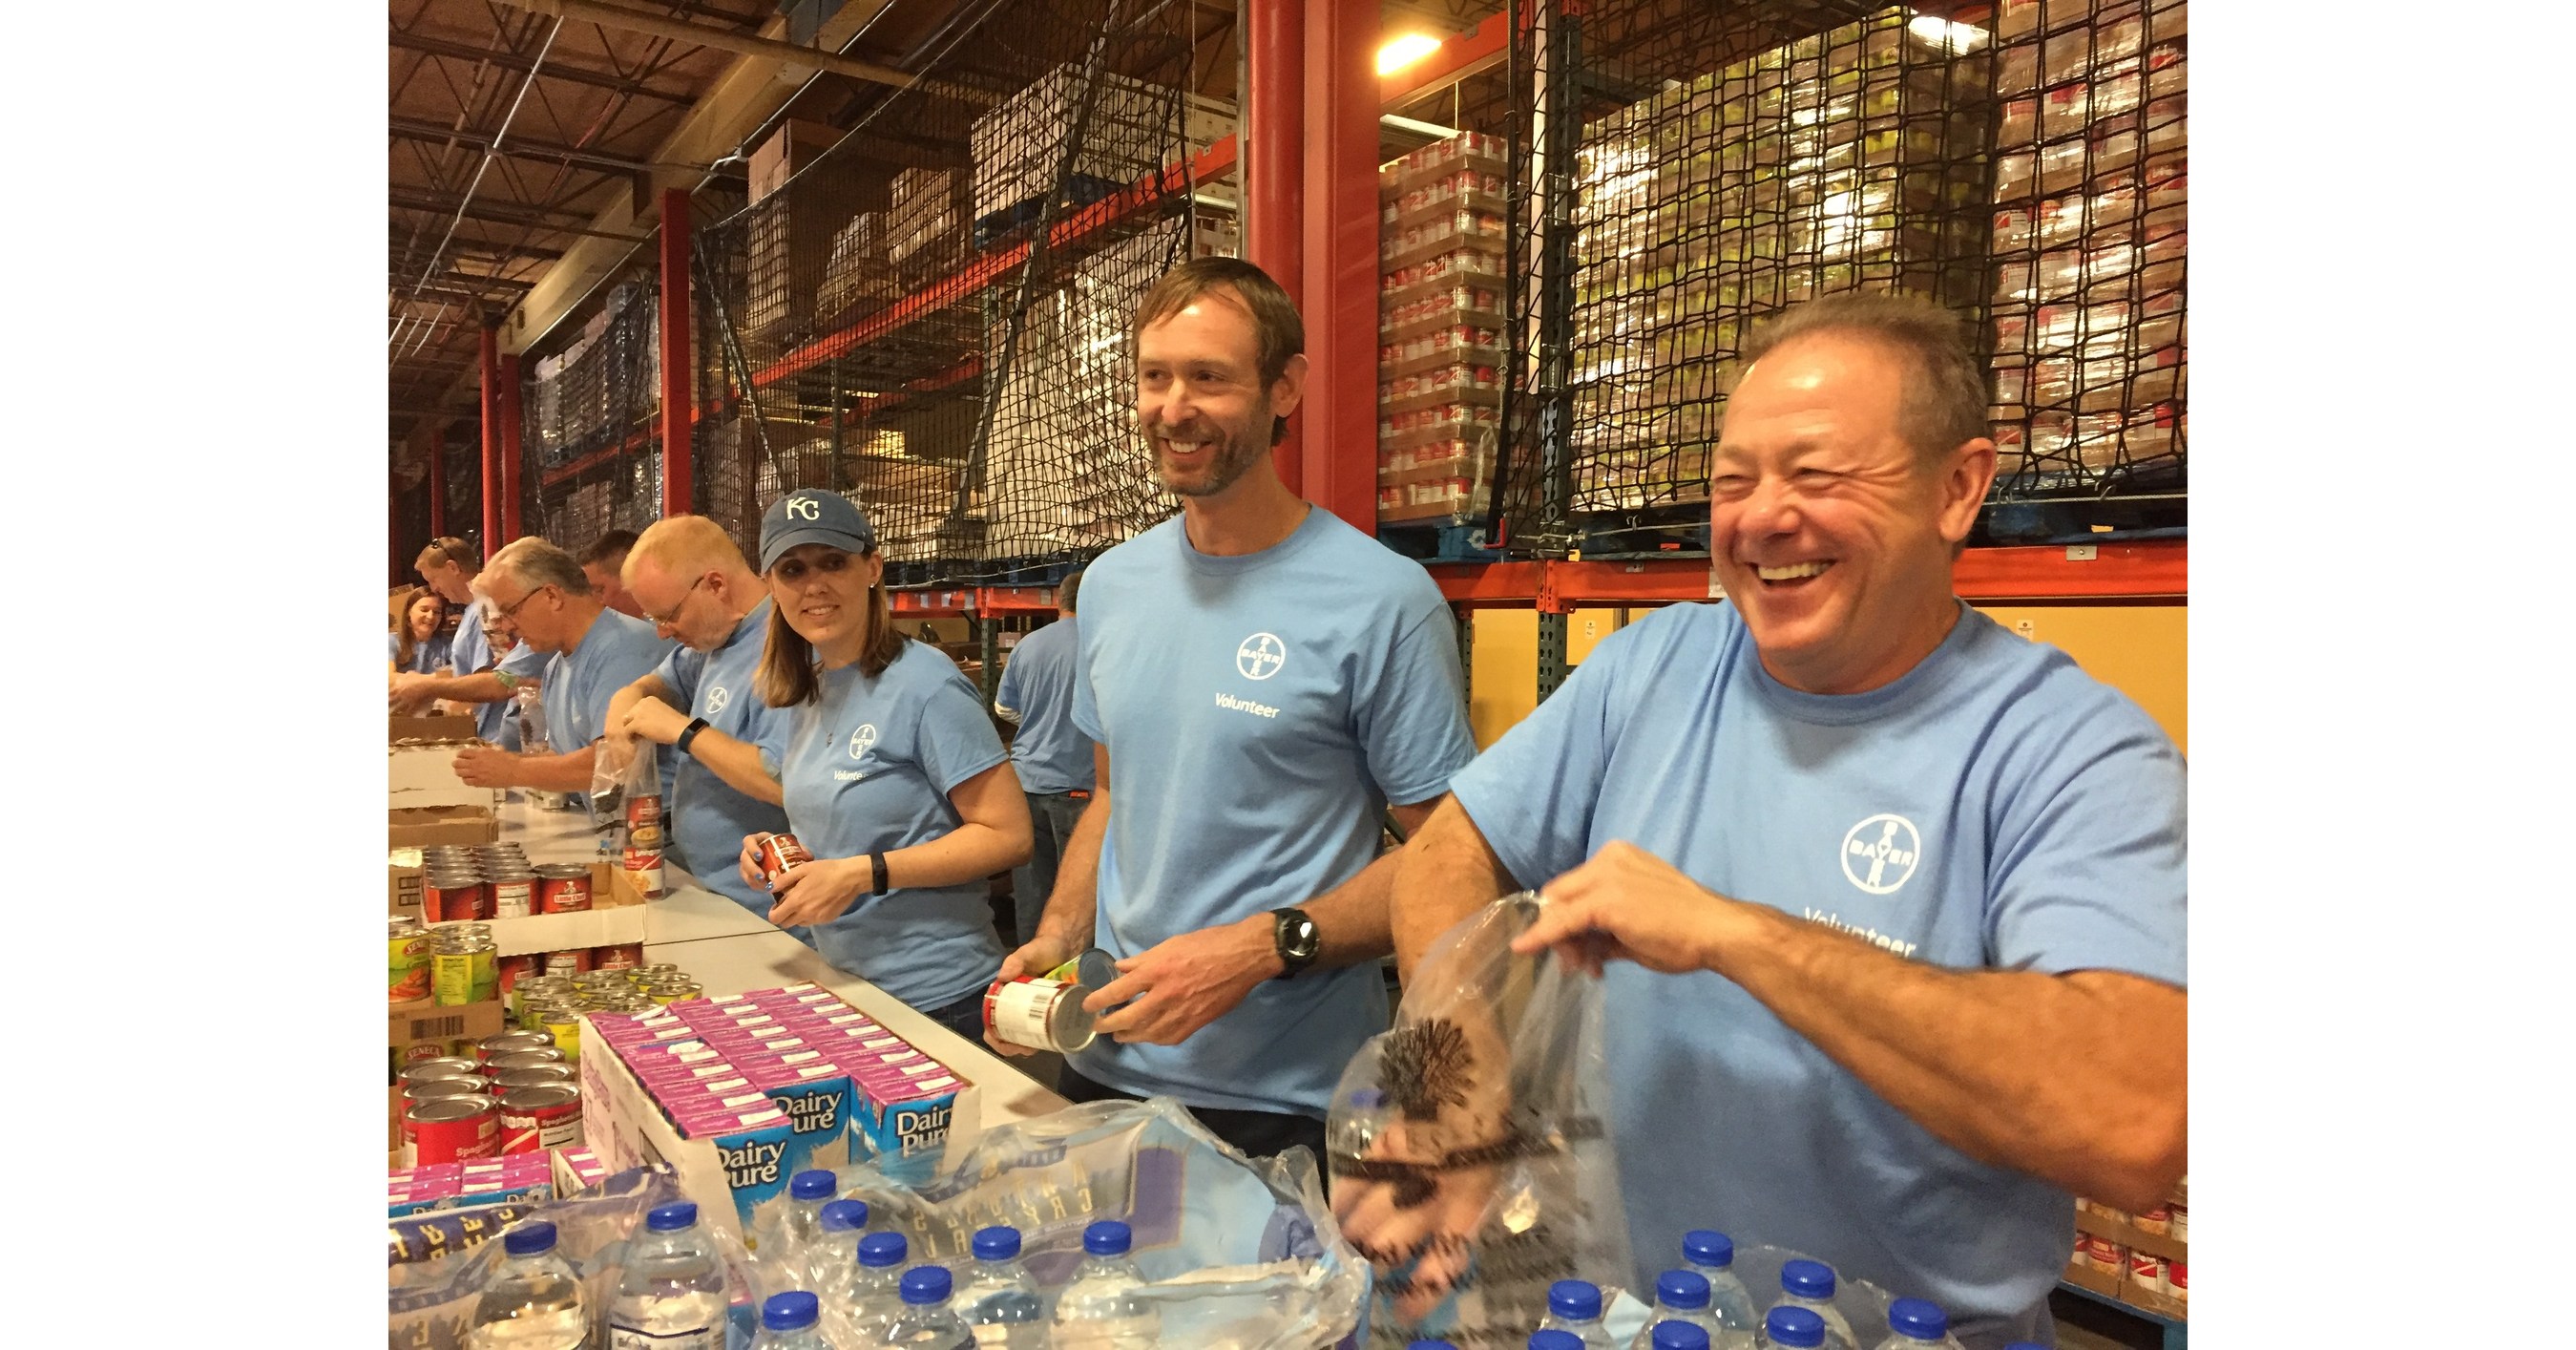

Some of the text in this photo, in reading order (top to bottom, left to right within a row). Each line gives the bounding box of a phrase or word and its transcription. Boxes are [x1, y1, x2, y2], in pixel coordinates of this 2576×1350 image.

[786, 496, 820, 520] KC
[1241, 648, 1281, 664] BAYER
[1215, 692, 1280, 719] Volunteer
[834, 770, 869, 781] Volunte
[1849, 839, 1914, 866] BAYER
[408, 1045, 440, 1061] SENECA
[774, 1091, 843, 1119] Dairy
[793, 1111, 834, 1133] ure
[897, 1106, 953, 1135] Dair
[725, 1164, 778, 1188] ure
